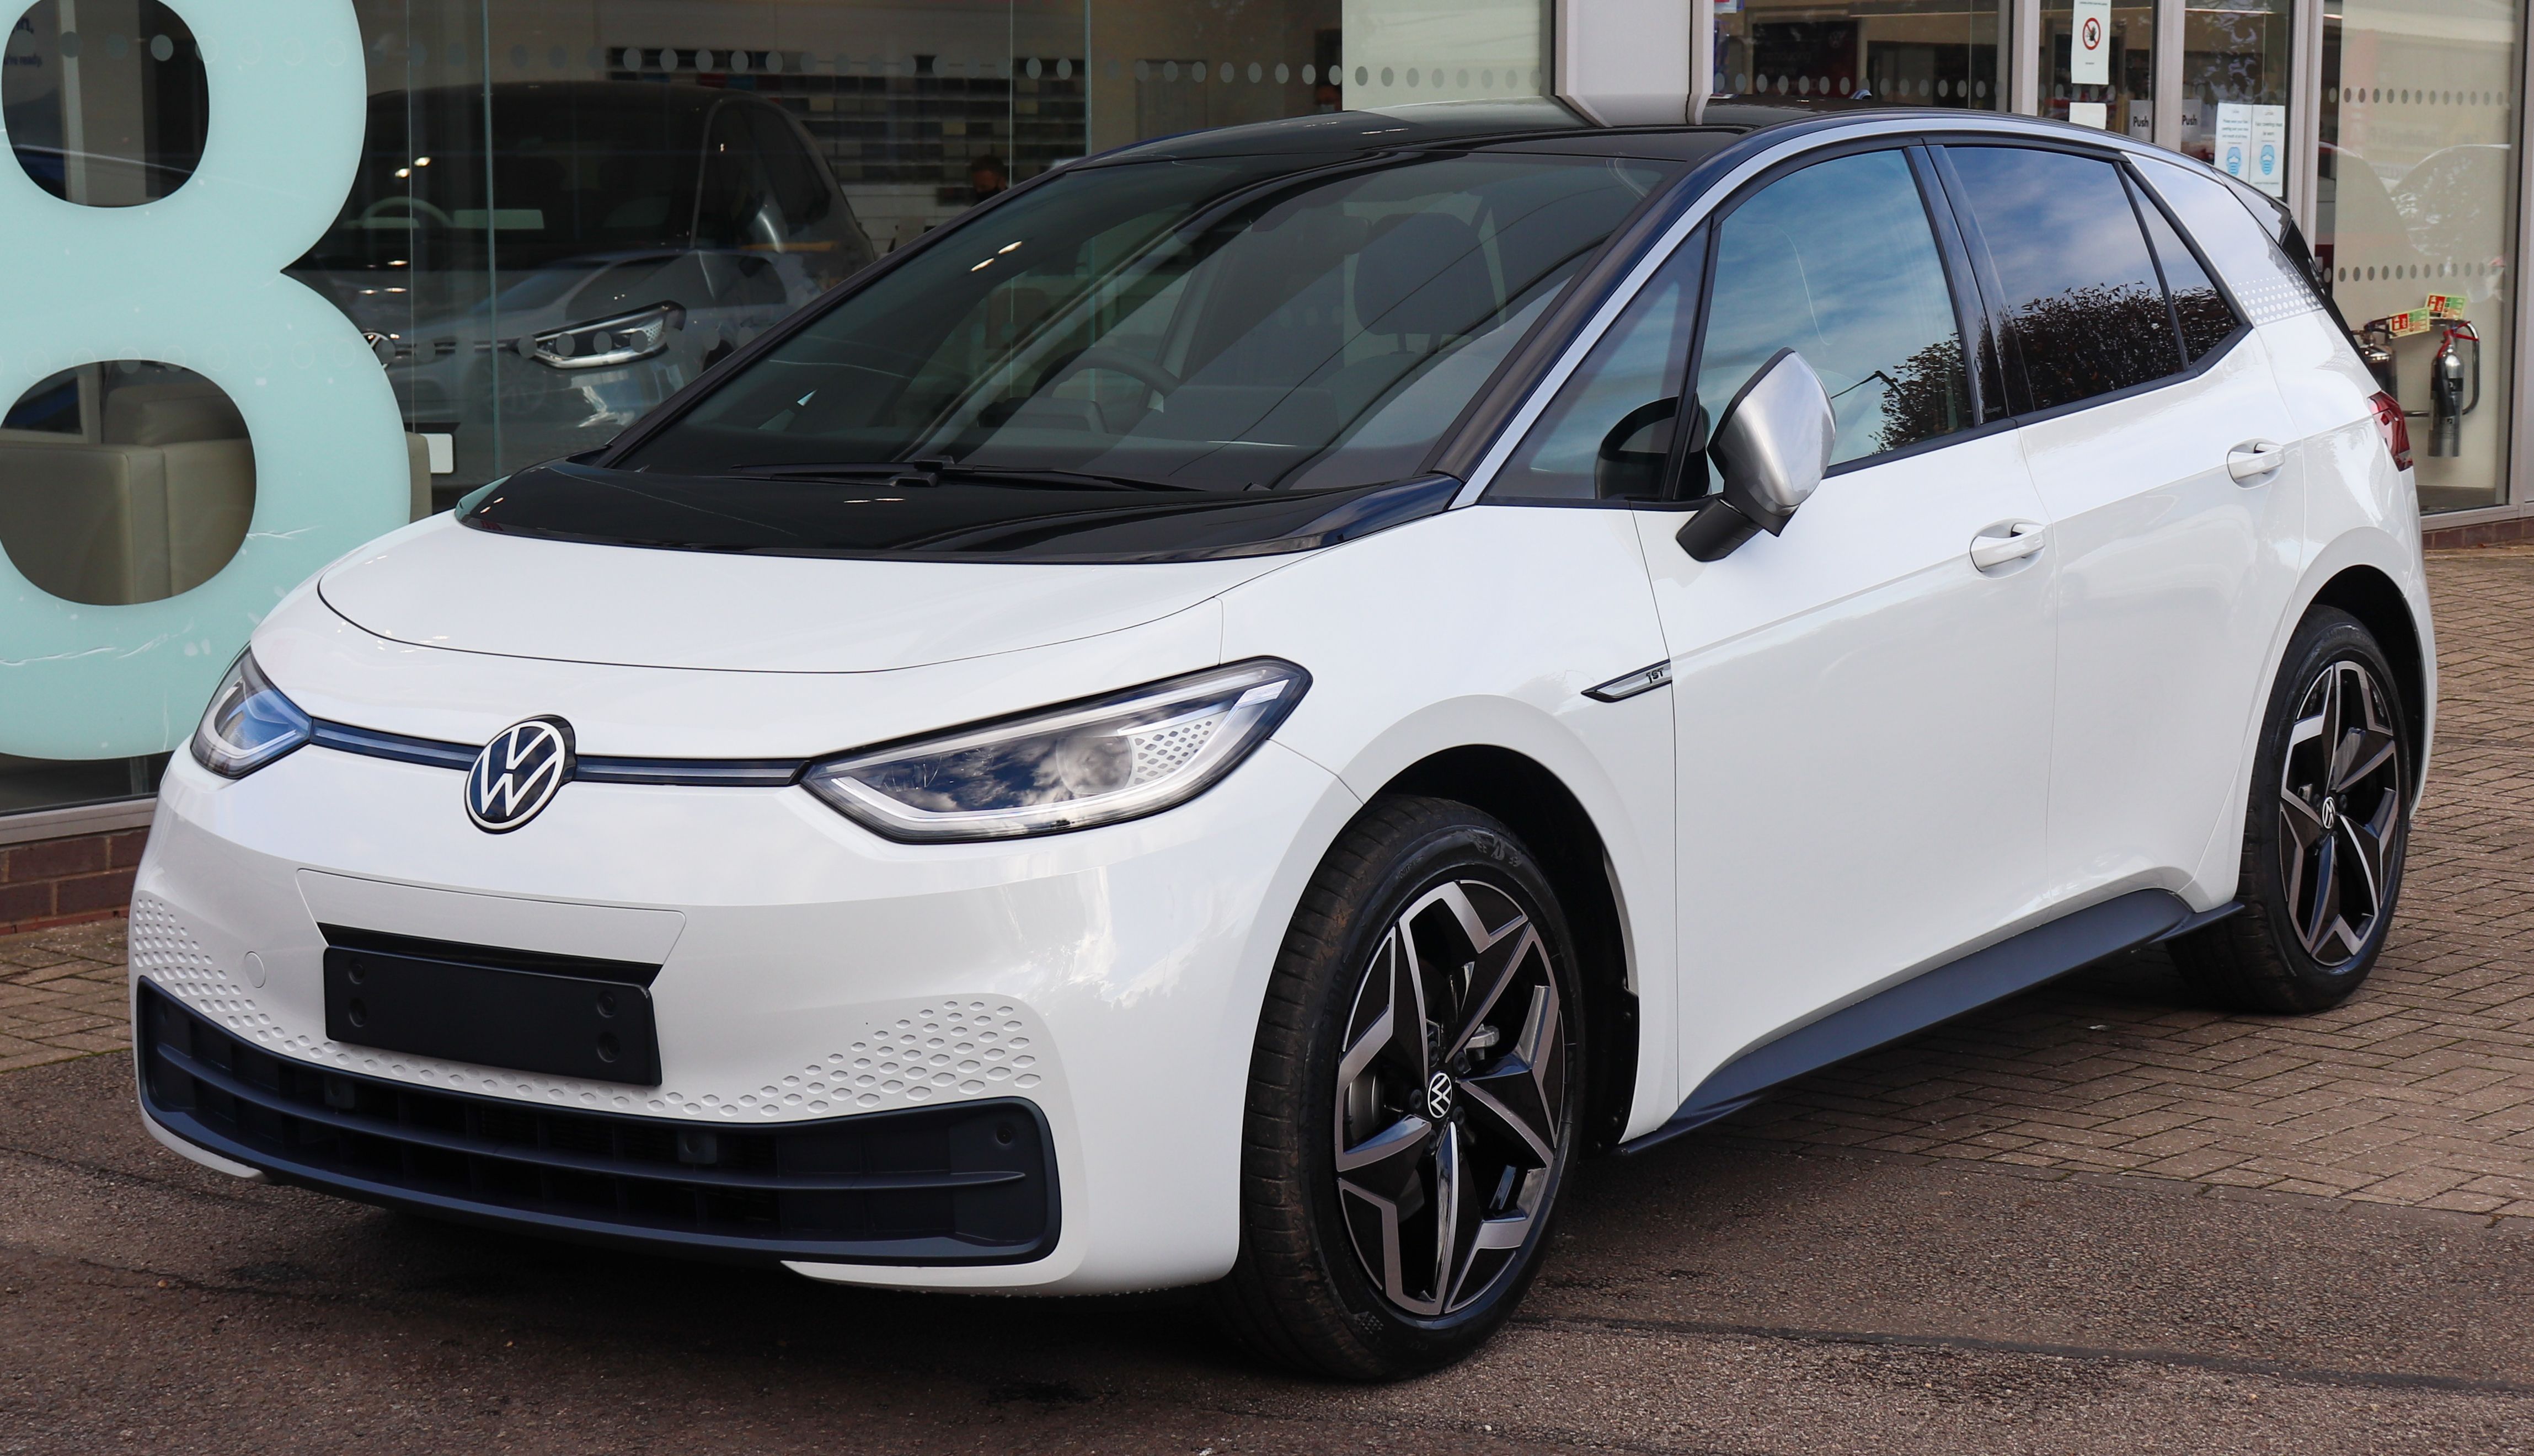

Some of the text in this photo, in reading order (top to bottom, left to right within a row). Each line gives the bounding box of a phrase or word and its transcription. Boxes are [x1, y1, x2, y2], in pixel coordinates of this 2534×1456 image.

[2133, 115, 2149, 127] Push
[2182, 114, 2197, 125] Push
[1646, 667, 1664, 684] 1ST
[466, 720, 565, 830] VW
[1428, 1073, 1452, 1118] VW
